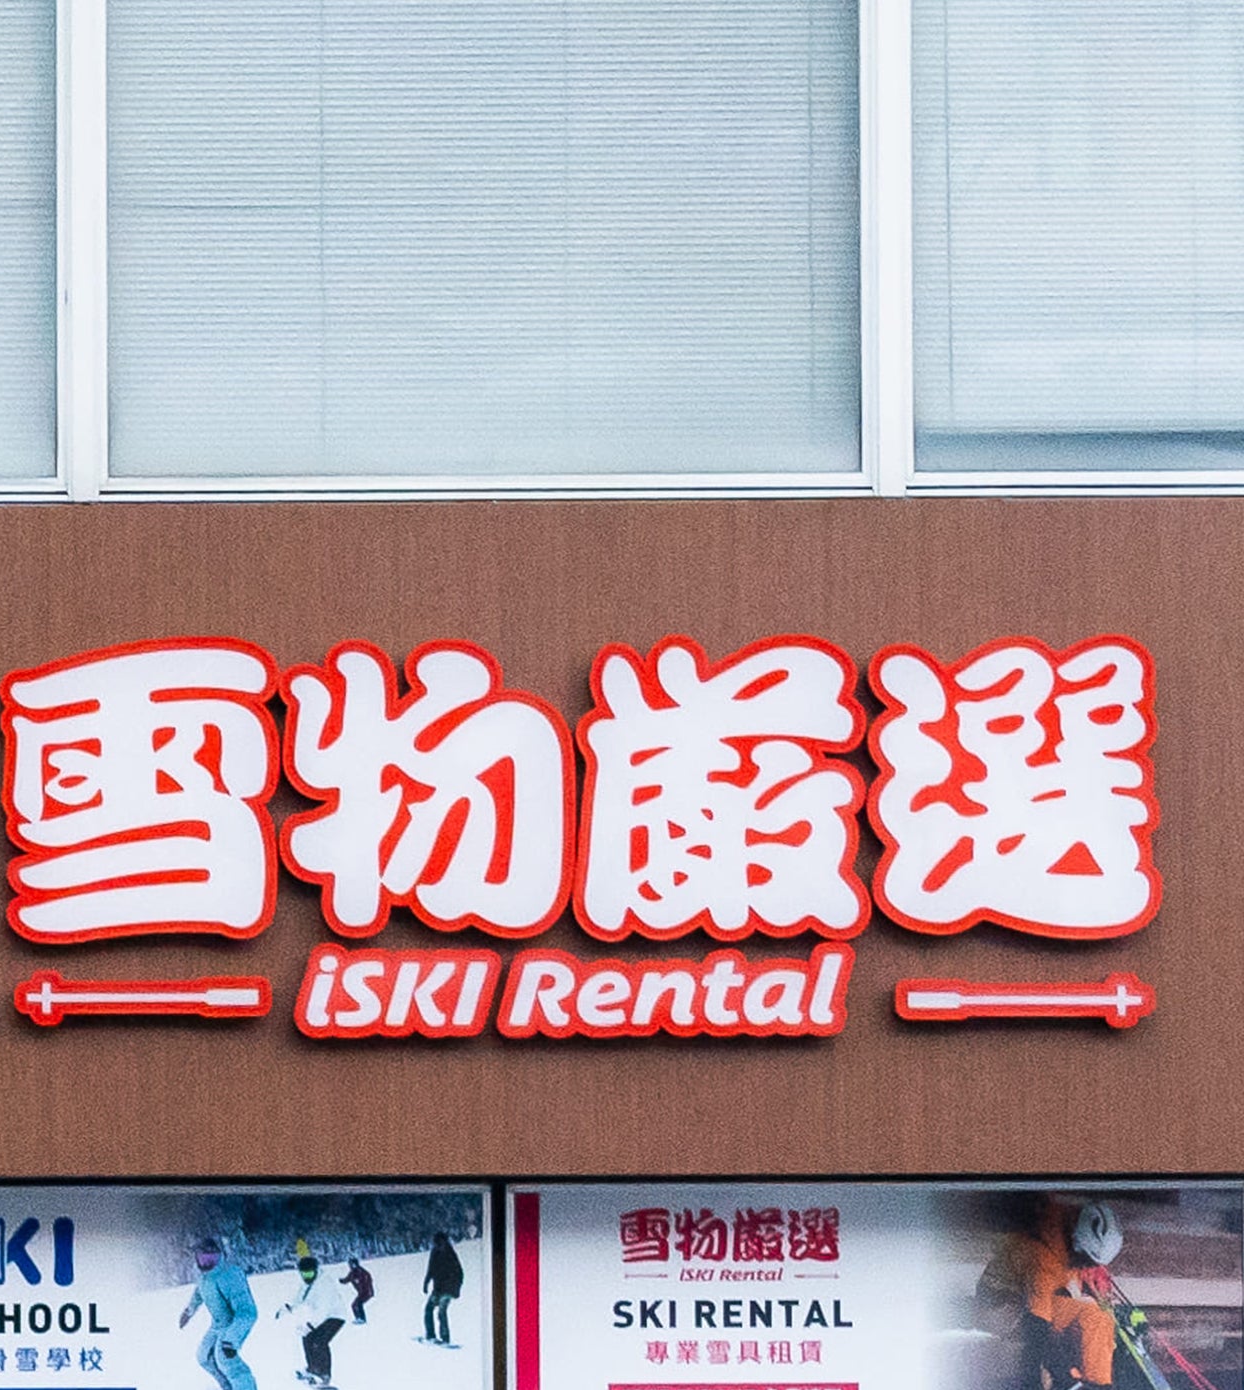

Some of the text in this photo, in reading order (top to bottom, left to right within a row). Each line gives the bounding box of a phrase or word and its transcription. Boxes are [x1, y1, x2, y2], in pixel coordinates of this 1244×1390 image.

[304, 948, 846, 1031] iSKI Rental
[720, 1268, 784, 1282] Rental
[613, 1300, 853, 1328] SKI RENTAL
